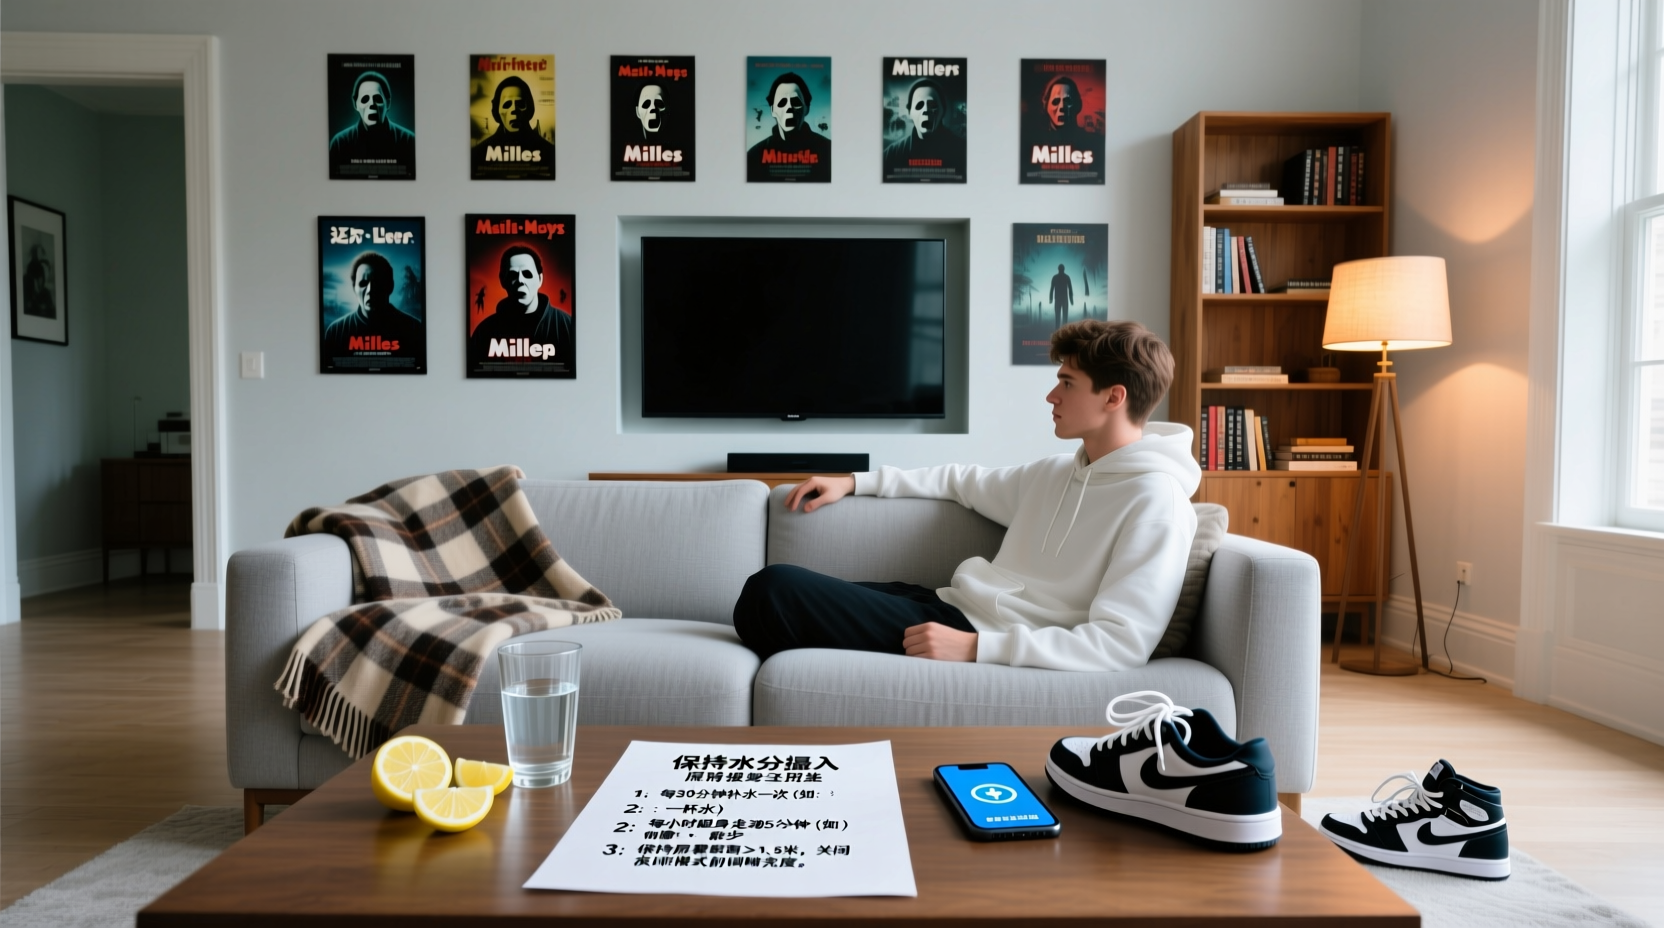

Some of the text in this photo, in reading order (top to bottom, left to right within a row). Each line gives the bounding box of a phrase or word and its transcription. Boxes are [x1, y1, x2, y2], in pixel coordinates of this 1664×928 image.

[624, 145, 683, 163] Milles
[1032, 145, 1094, 164] Milles
[348, 335, 400, 350] Milles
[488, 338, 556, 360] Millep
